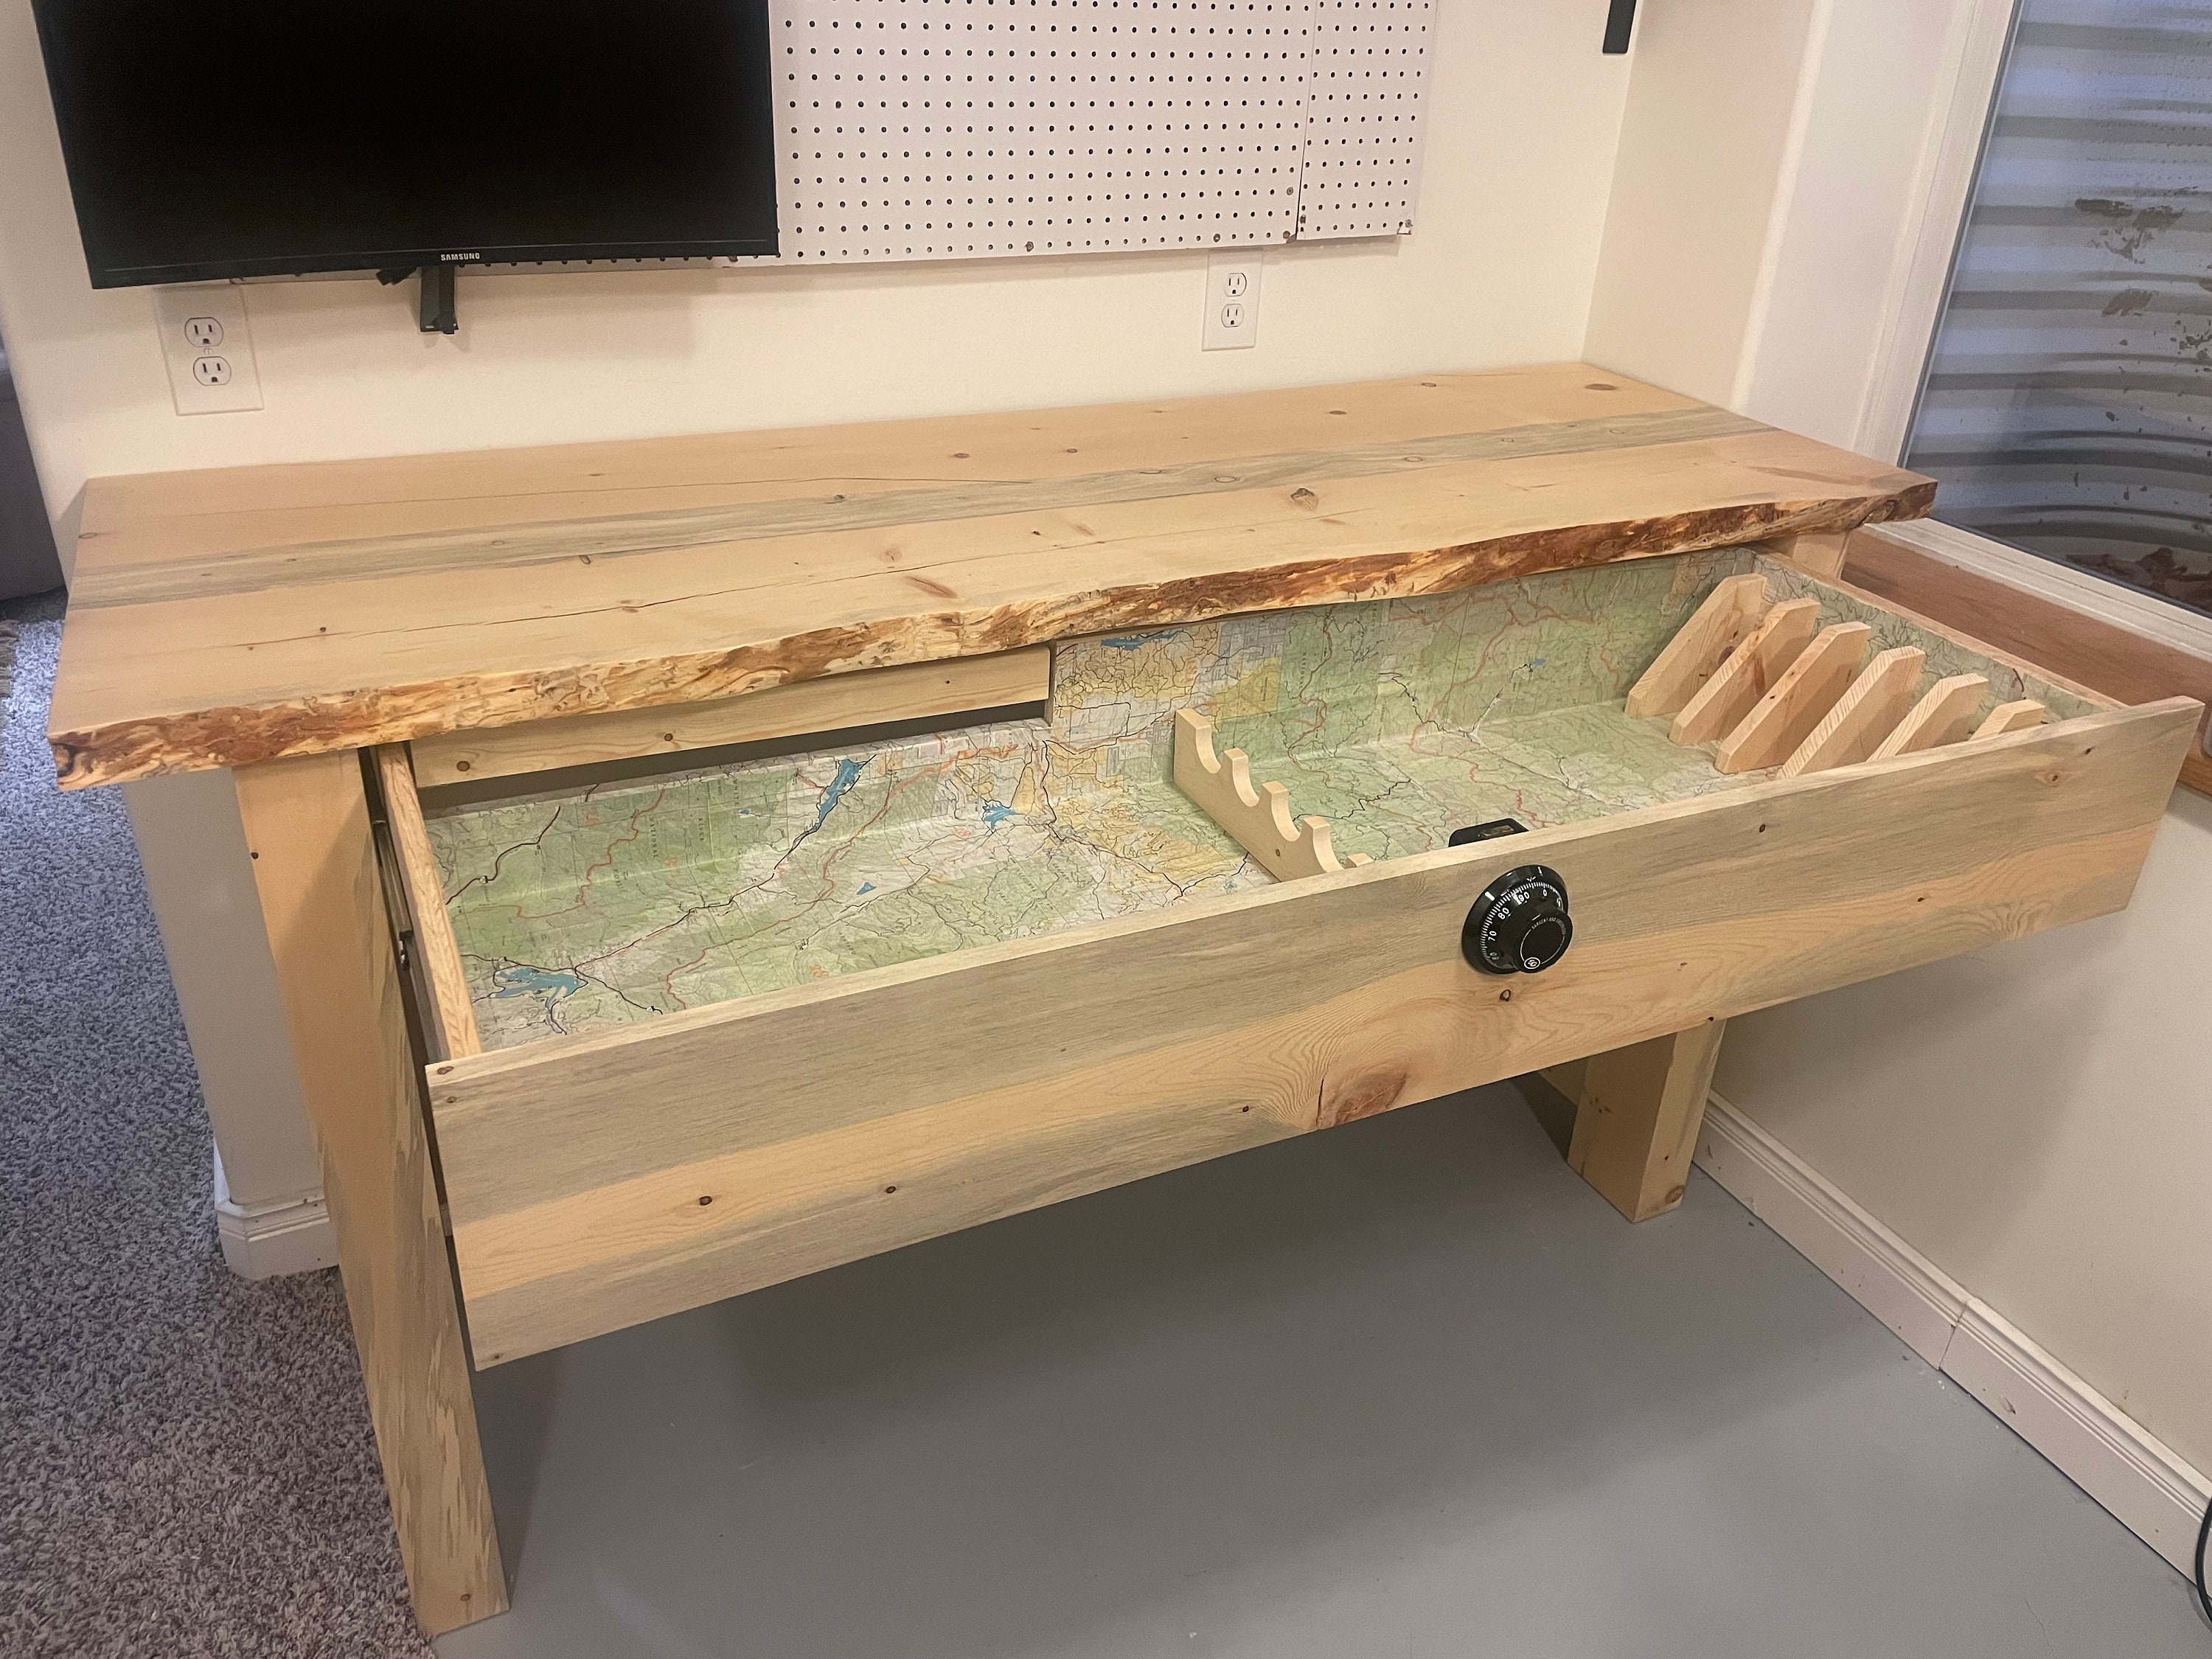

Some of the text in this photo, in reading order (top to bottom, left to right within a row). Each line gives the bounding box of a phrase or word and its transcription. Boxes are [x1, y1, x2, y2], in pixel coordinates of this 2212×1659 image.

[440, 252, 481, 262] SAMSUNG
[1498, 907, 1509, 919] 80
[1488, 931, 1497, 942] 70
